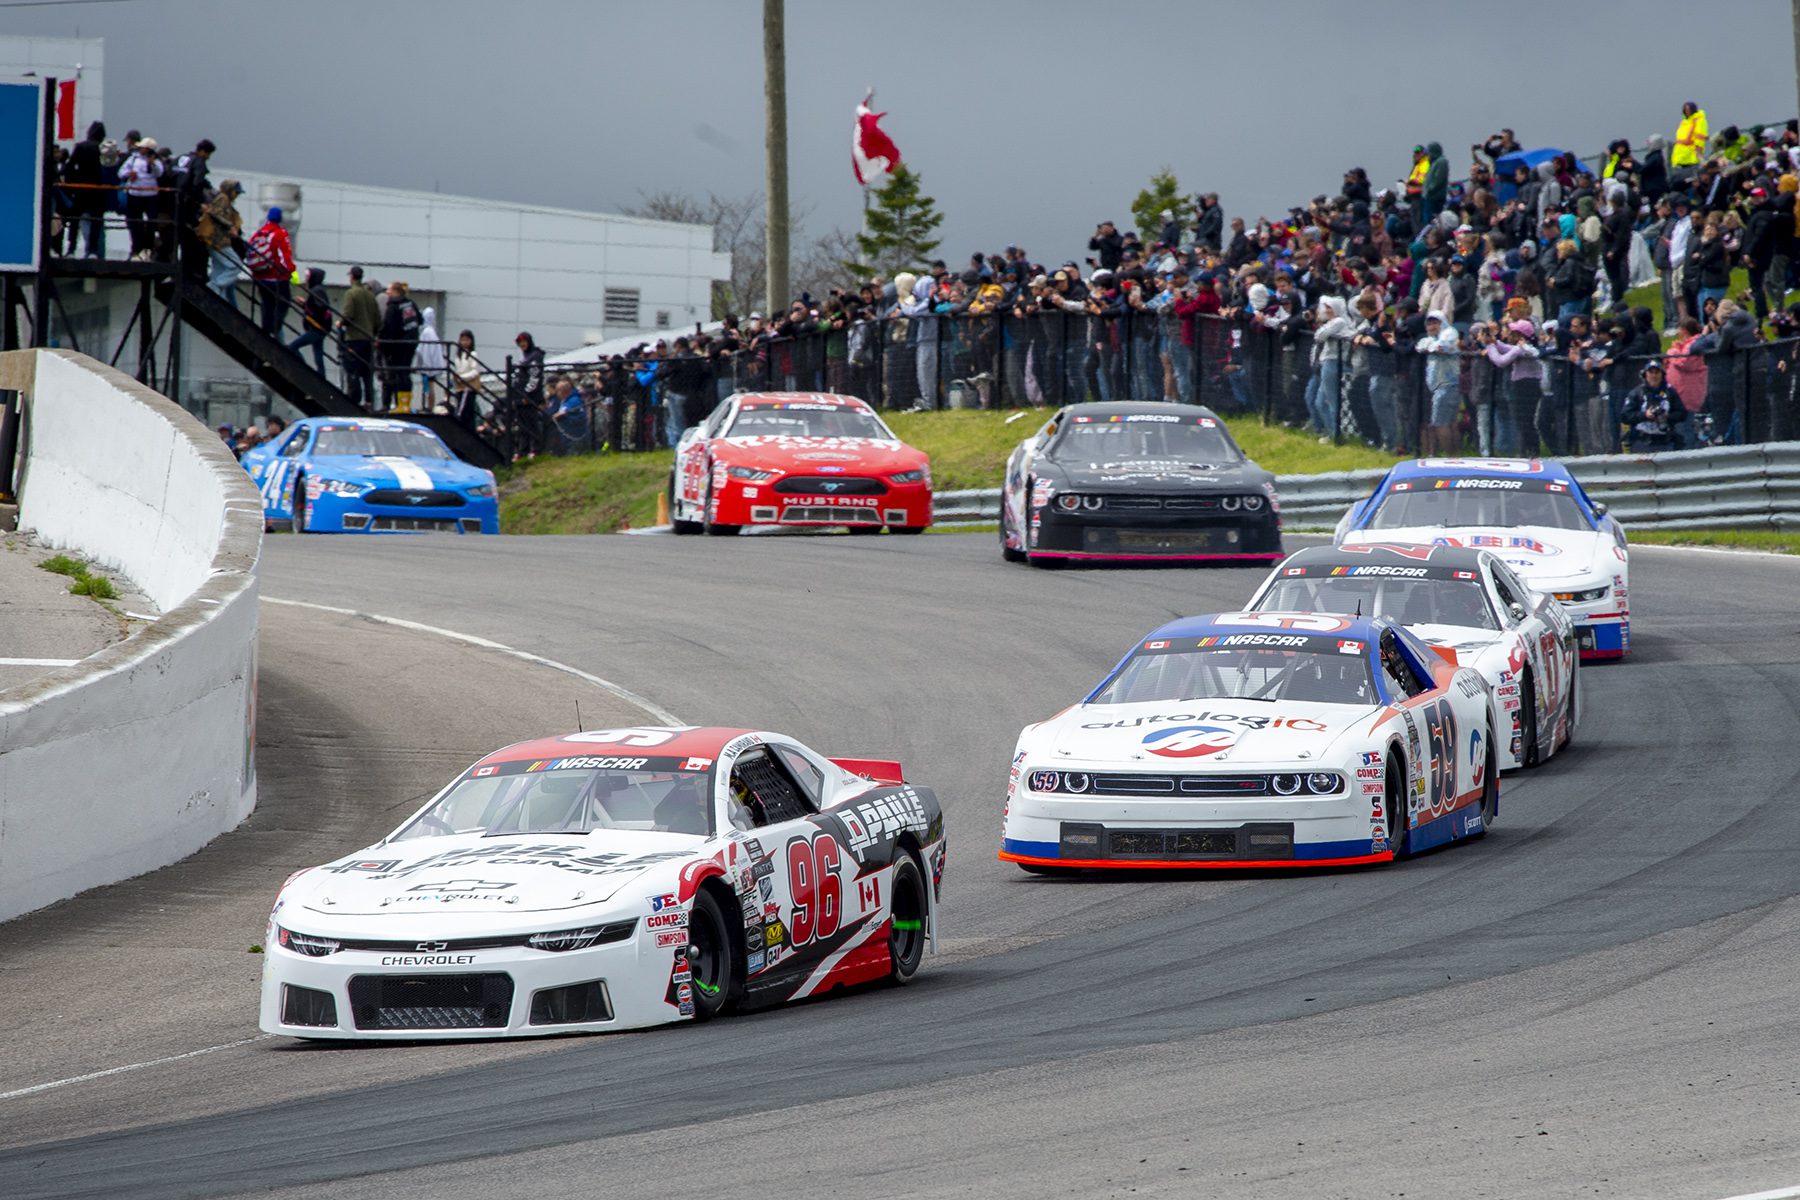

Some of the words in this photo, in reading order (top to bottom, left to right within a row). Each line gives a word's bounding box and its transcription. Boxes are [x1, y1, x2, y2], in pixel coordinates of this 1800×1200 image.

[1126, 414, 1181, 423] NASCAR
[1455, 479, 1523, 490] NASCAR
[783, 497, 879, 506] MUSTANG
[1353, 566, 1428, 577] NASCAR
[1222, 634, 1309, 647] NASCAR
[553, 757, 649, 770] NASCAR
[1362, 752, 1382, 766] JE
[1422, 697, 1458, 818] 59
[1357, 769, 1379, 778] COMP
[1035, 771, 1057, 792] 59
[1363, 784, 1384, 794] SIMPSON
[1467, 815, 1482, 829] SCOTT
[486, 857, 647, 876] CANADA
[787, 831, 842, 952] 96
[652, 893, 677, 912] JE
[647, 913, 679, 928] COMP
[657, 932, 687, 946] SIMPSON
[381, 955, 475, 966] CHEVROLET
